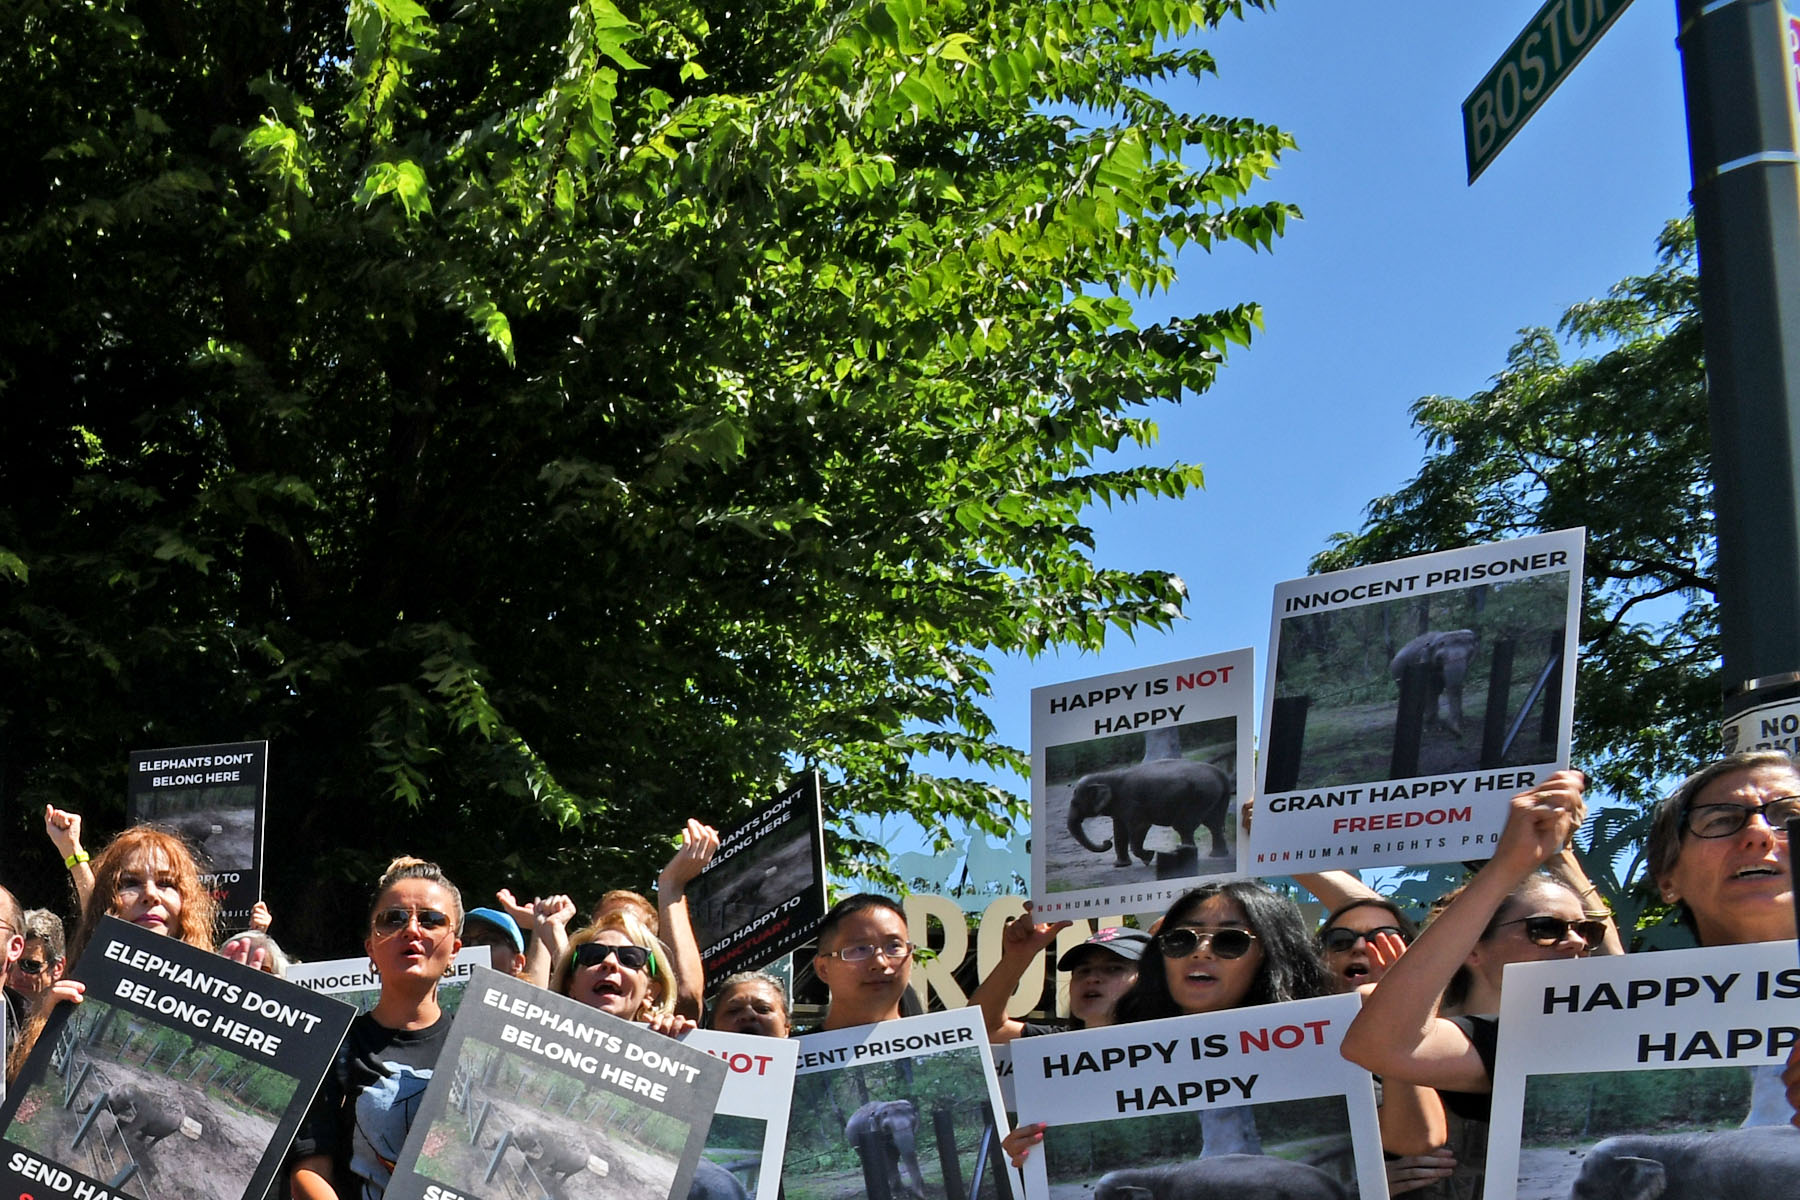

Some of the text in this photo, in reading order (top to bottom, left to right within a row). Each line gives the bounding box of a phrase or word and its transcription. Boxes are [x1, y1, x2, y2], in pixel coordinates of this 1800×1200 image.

[1285, 550, 1568, 612] INNOCENT PRISONER
[1050, 666, 1235, 714] HAPPY IS NOT
[1094, 705, 1186, 735] HAPPY
[1761, 714, 1799, 738] NO
[139, 753, 253, 772] ELEPHANTS DON'T
[153, 771, 240, 787] BELONG HERE
[1269, 771, 1536, 813] GRANT HAPPY HER
[717, 788, 804, 850] HANTS DON'T
[1333, 806, 1472, 834] FREEDOM
[702, 811, 792, 874] BELONG HERE
[1257, 845, 1359, 863] NONHUMAN
[1373, 837, 1446, 853] RIGHTS
[198, 873, 240, 884] PPY TO
[216, 908, 250, 918] PROJEC
[733, 906, 779, 941] HAPPY
[783, 896, 801, 913] TO
[1037, 897, 1110, 913] NONHUMAN
[1121, 890, 1172, 904] RIGHTS
[709, 917, 790, 970] SANCTUARY
[737, 946, 772, 969] RIGHTS
[105, 939, 322, 1035] ELEPHANTS DON'T
[1543, 973, 1741, 1014] HAPPY
[115, 977, 283, 1056] BELONG HERE
[483, 987, 701, 1084] ELEPHANTS DON'T
[500, 1024, 667, 1102] BELONG HERE
[795, 1026, 974, 1070] CENT PRISONER
[1043, 1040, 1180, 1078] HAPPY
[1192, 1034, 1228, 1058] IS
[1240, 1020, 1331, 1055] NOT
[1638, 1026, 1798, 1062] HAPP
[1116, 1073, 1260, 1113] HAPPY
[8, 1152, 74, 1197] SEND
